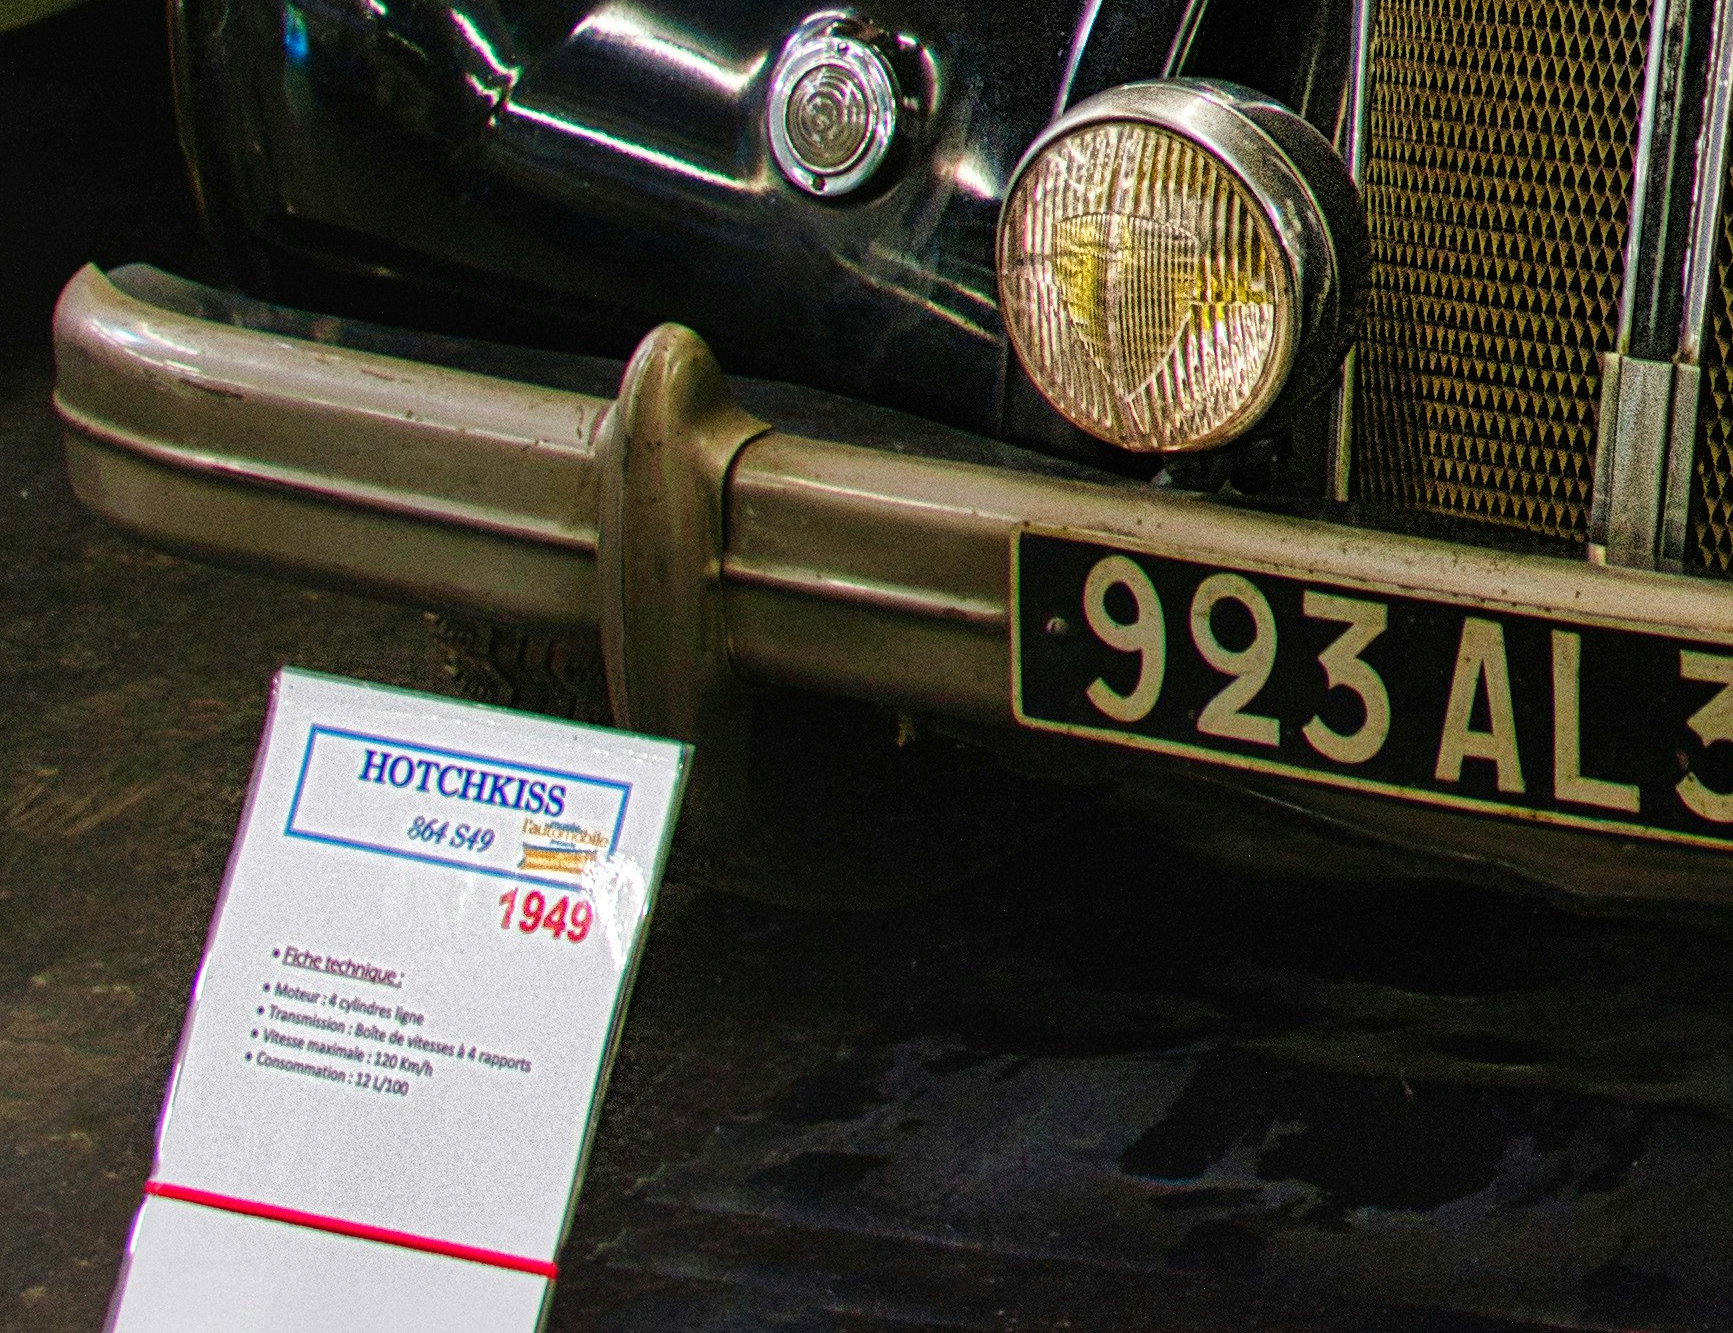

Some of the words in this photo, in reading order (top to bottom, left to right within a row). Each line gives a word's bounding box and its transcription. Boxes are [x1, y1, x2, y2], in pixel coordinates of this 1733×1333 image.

[1081, 554, 1392, 765] 923
[1434, 616, 1641, 814] AL
[358, 749, 567, 817] HOTCHKISS
[407, 814, 449, 843] 864
[449, 823, 495, 853] S49
[499, 888, 593, 943] 1949
[282, 945, 322, 970] Fiche
[325, 955, 397, 985] technique
[274, 982, 321, 1004] Moteur
[328, 993, 338, 1007] 4
[339, 996, 392, 1019] cylindres
[394, 1005, 424, 1026] ligne
[263, 1028, 305, 1050] Vitesse
[307, 1039, 365, 1062] maximale
[374, 1051, 398, 1069] 120
[400, 1056, 433, 1077] Km/h
[269, 1004, 346, 1033] Transmission
[388, 1030, 405, 1046] de
[407, 1034, 455, 1057] vitesses
[467, 1045, 477, 1061] 4
[478, 1051, 532, 1073] rapports
[256, 1050, 346, 1083] Consommation
[355, 1071, 371, 1088] 12
[373, 1075, 409, 1096] L/100
